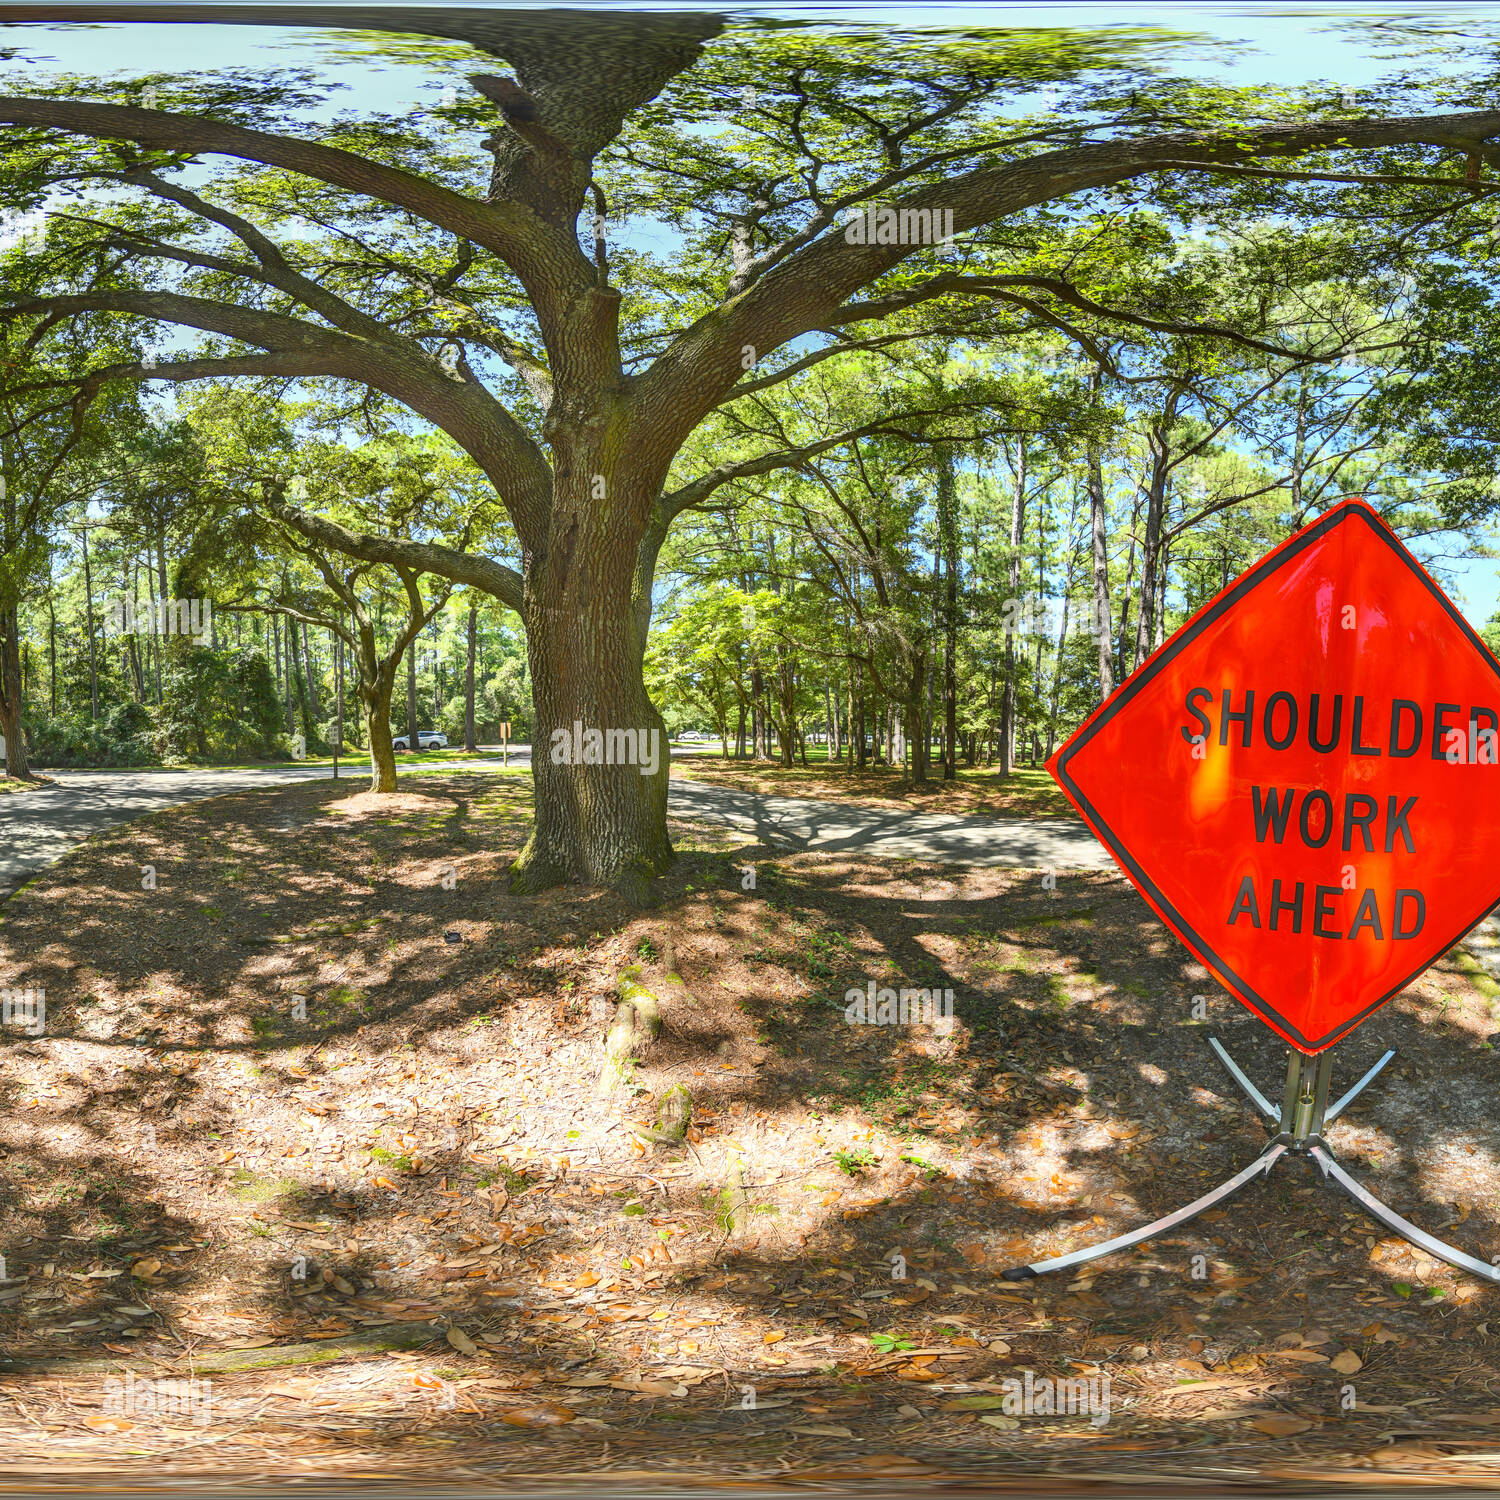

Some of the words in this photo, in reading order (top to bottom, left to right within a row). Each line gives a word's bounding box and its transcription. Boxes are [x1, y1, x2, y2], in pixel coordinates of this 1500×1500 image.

[1181, 687, 1499, 763] SHOULDER
[1252, 785, 1419, 853] WORK
[1227, 876, 1426, 940] AHEAD
